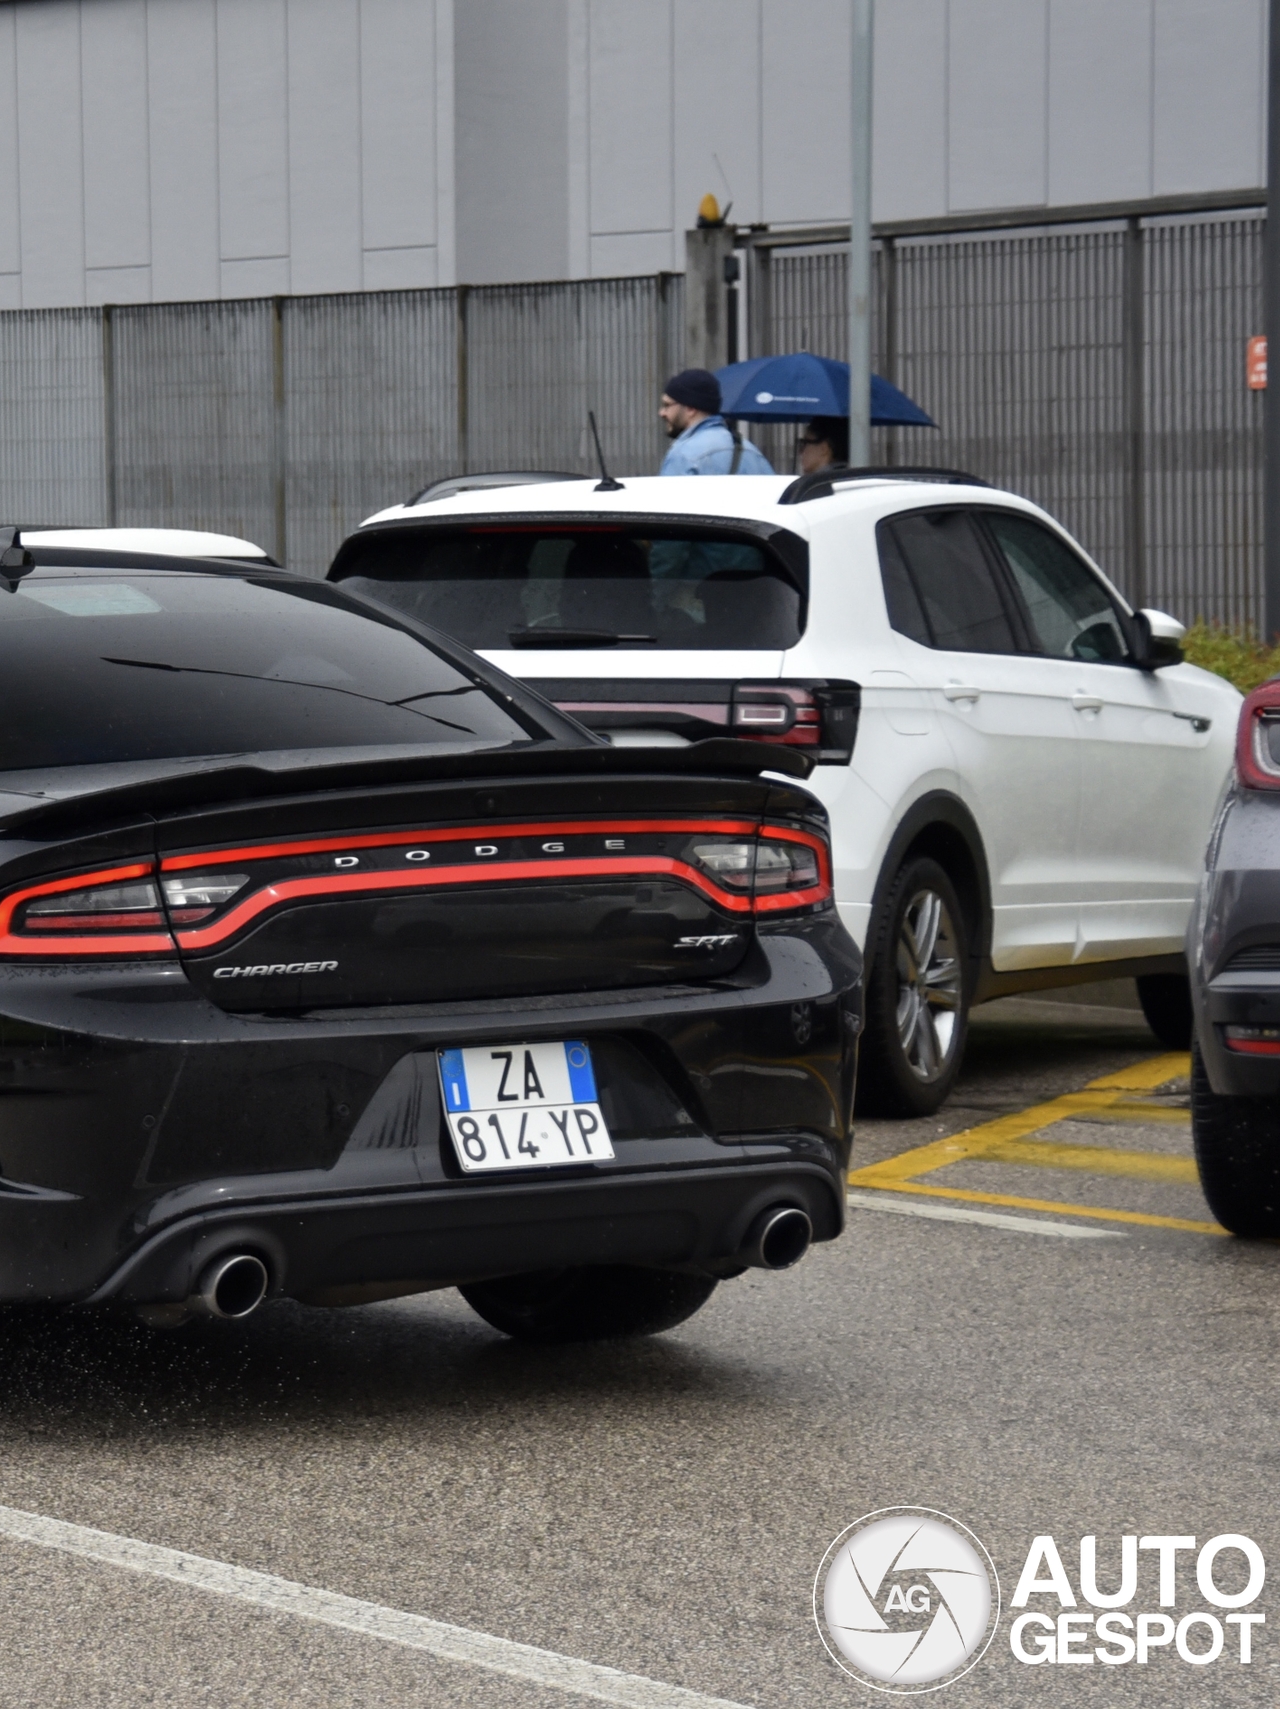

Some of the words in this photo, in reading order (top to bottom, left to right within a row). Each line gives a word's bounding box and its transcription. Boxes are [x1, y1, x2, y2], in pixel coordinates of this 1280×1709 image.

[334, 839, 626, 868] DODGE
[673, 934, 738, 950] SRT
[213, 960, 339, 979] CHARGER
[491, 1050, 545, 1102] ZA
